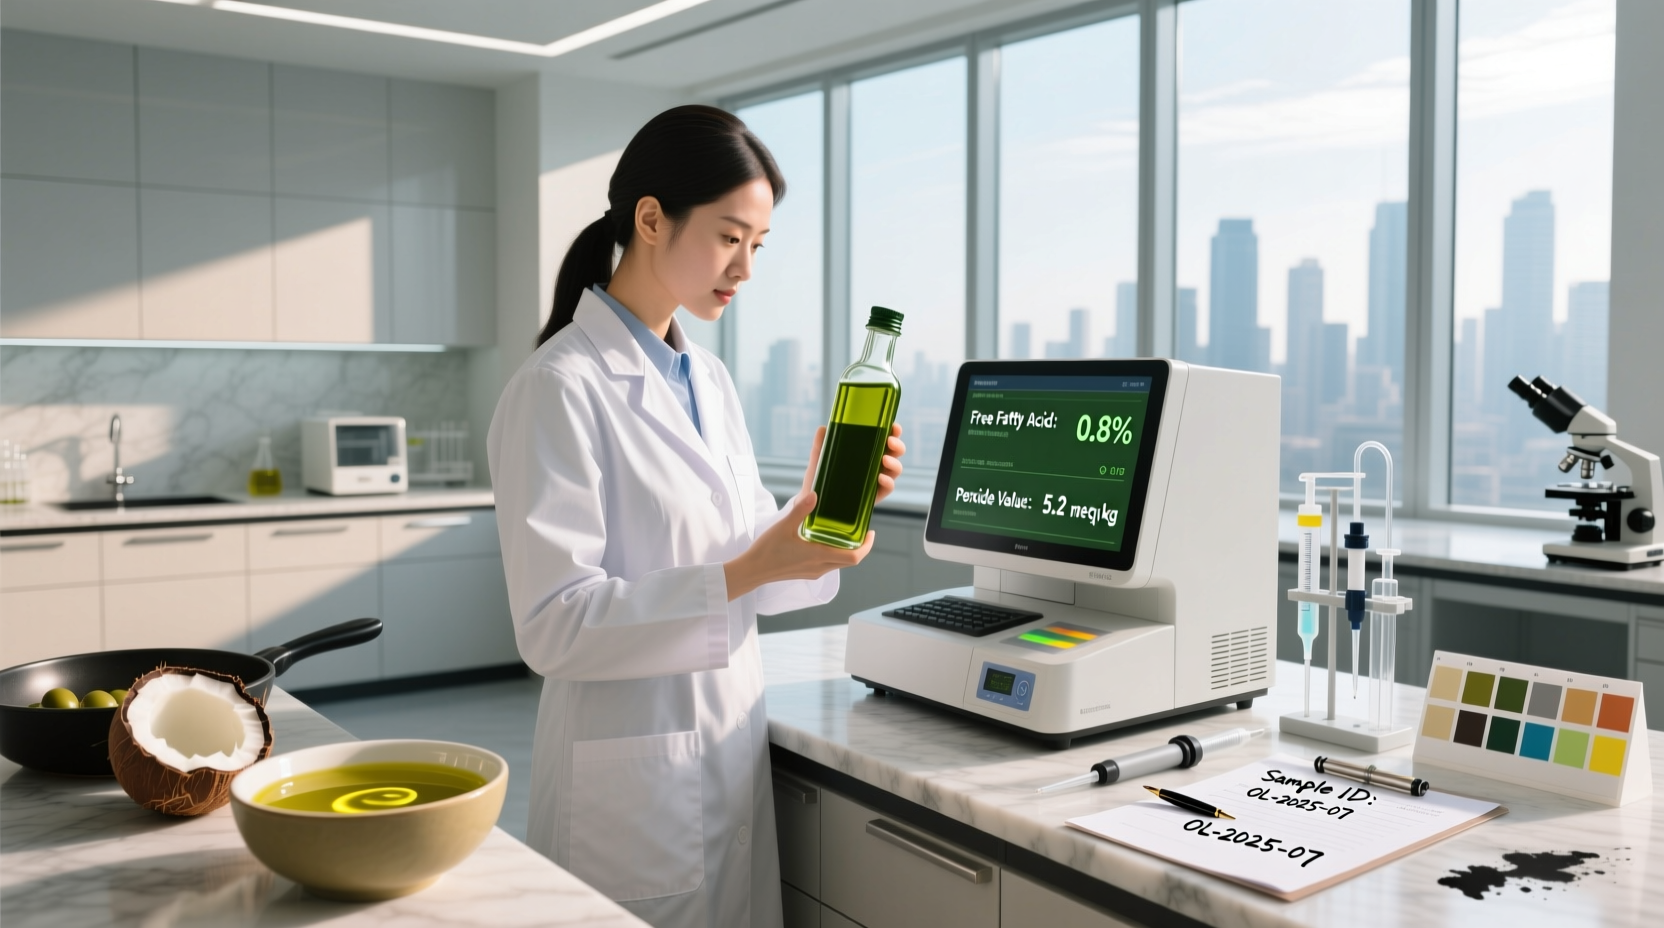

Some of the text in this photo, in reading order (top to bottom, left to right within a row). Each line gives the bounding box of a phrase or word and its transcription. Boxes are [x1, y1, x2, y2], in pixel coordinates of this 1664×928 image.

[970, 410, 1133, 445] Free Fatty Acid: 0.8%
[998, 490, 1032, 509] Value:
[1042, 493, 1067, 516] 5.2
[1247, 787, 1354, 820] OL-2025-07
[1261, 770, 1377, 805] Sample ID:
[1183, 819, 1324, 867] OL-2025-07
